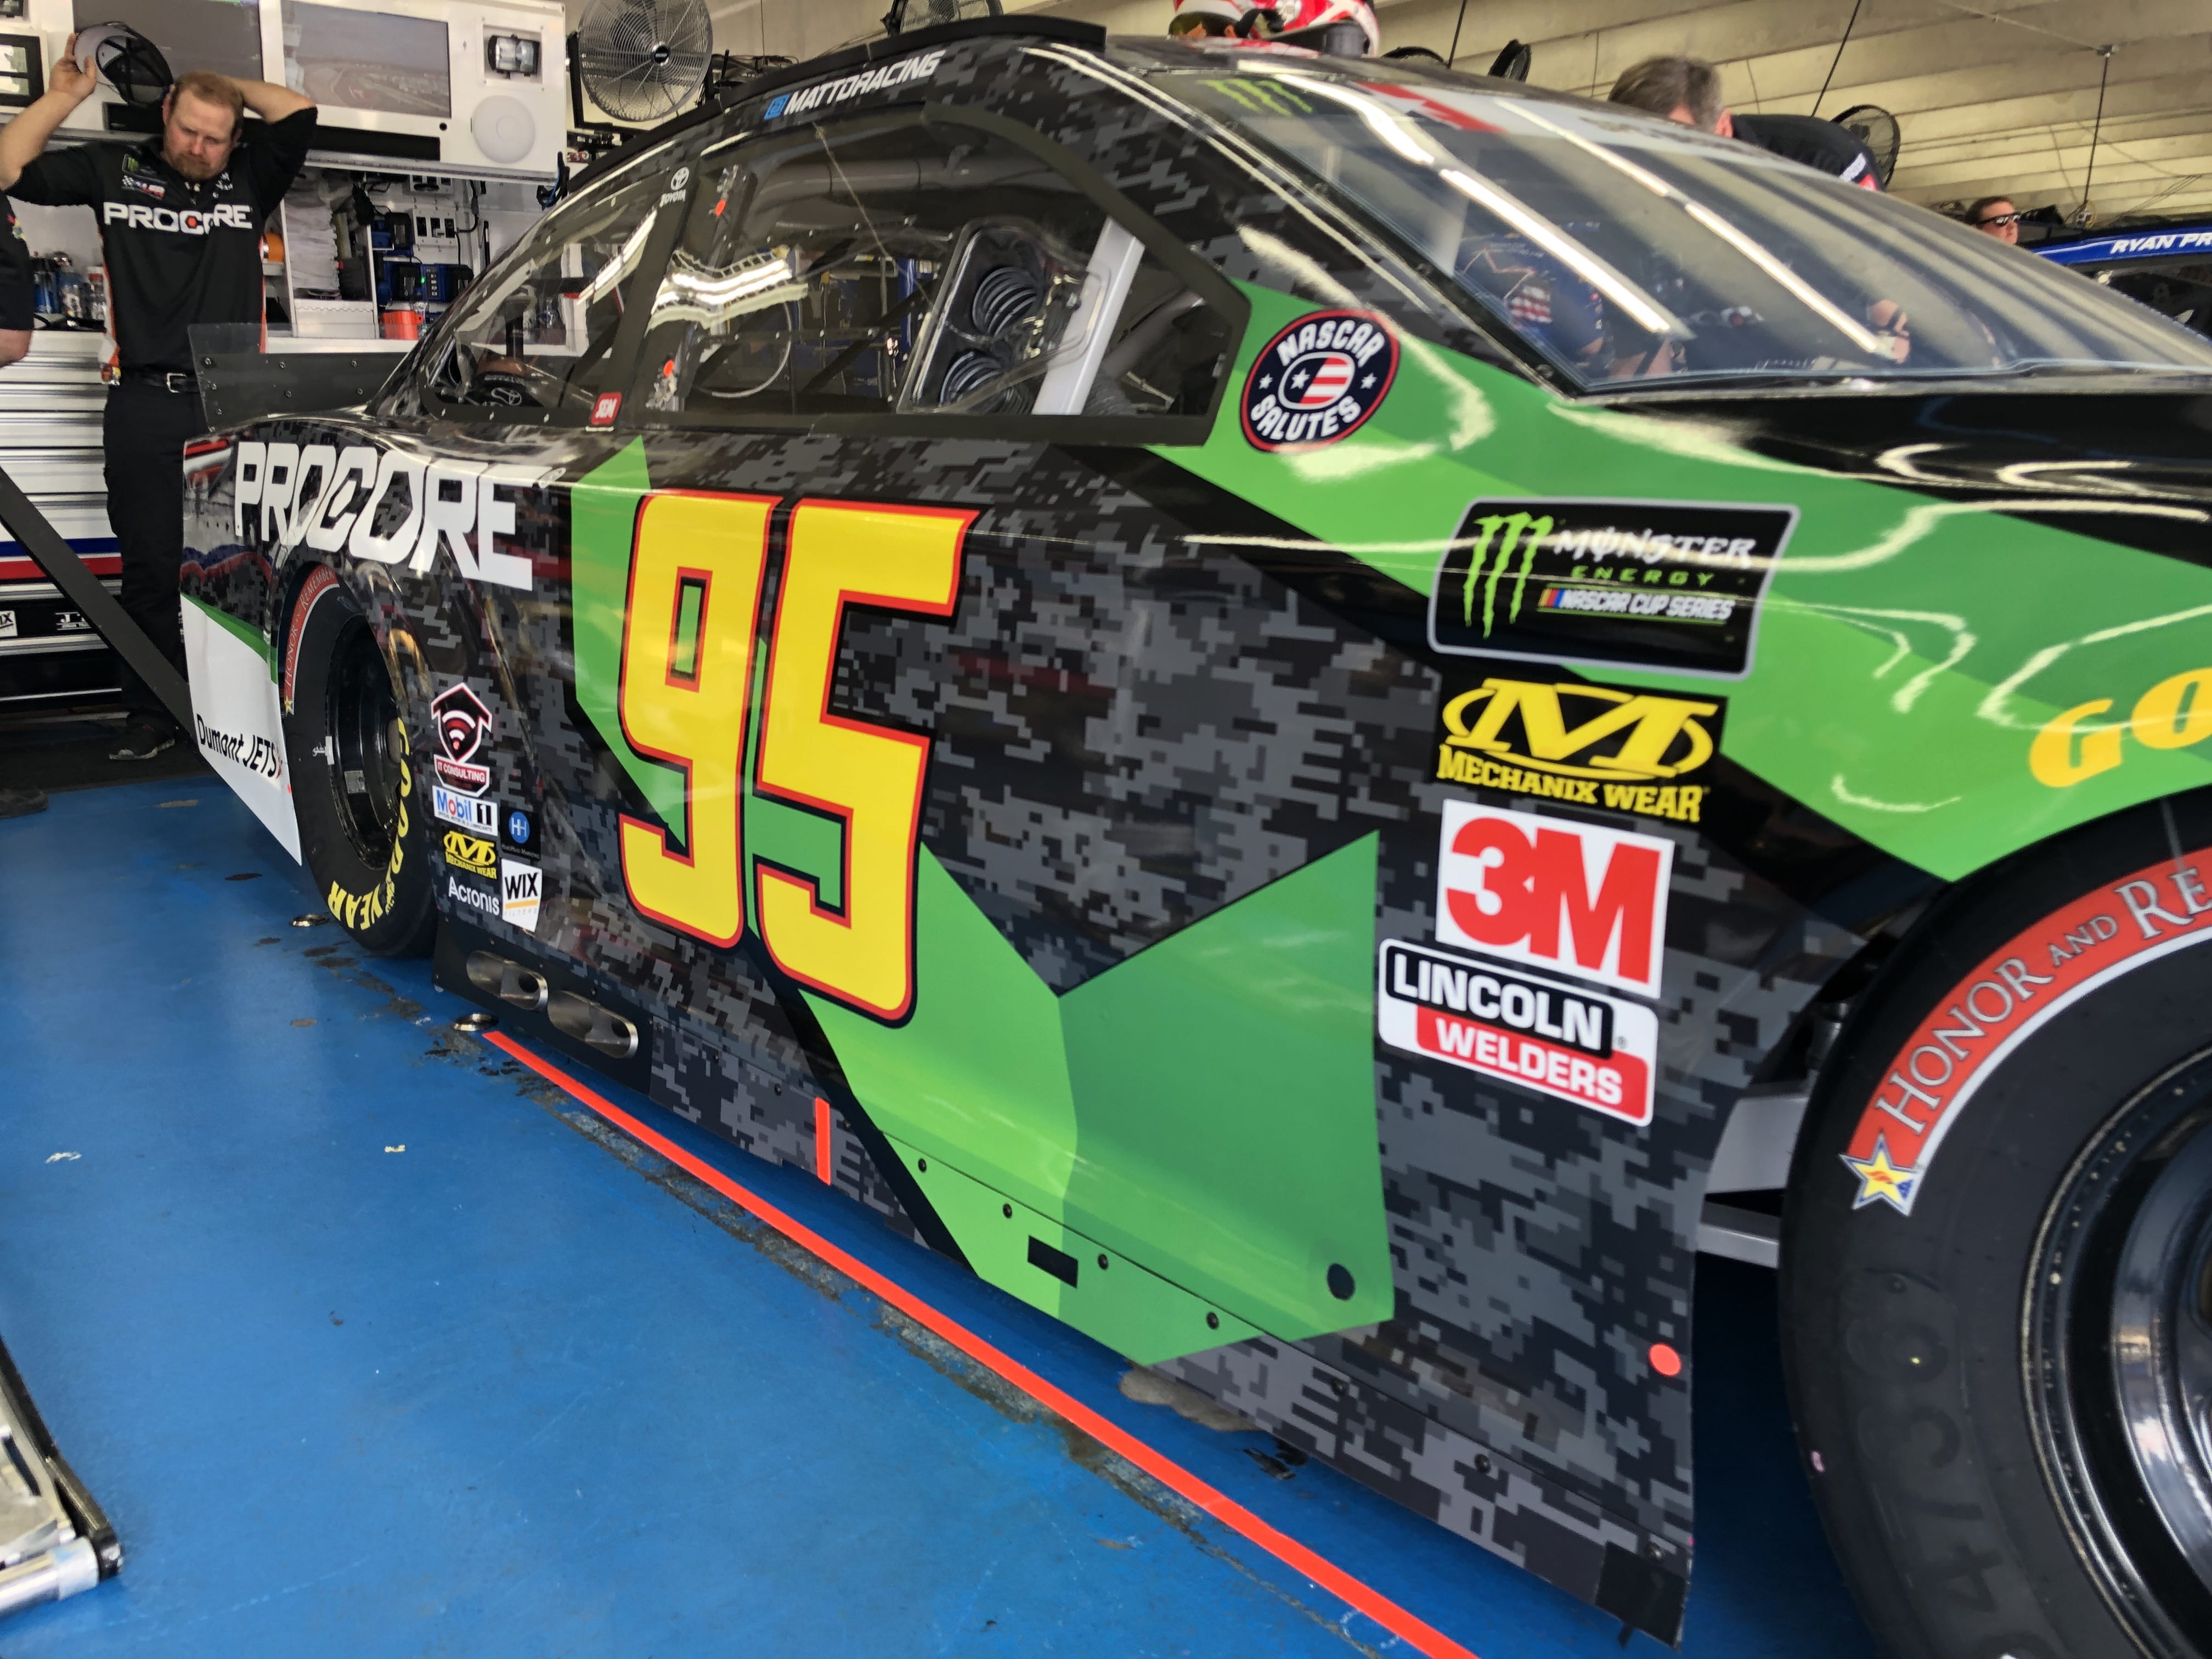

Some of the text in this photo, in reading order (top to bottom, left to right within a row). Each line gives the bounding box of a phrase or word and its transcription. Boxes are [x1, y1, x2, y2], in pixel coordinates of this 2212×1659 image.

[2110, 235, 2177, 254] RYAN
[1277, 320, 1385, 368] NASCAR
[1251, 394, 1362, 441] SALUTES
[235, 442, 555, 591] PROCORE
[1554, 527, 1756, 569] MONSTER
[1571, 566, 1714, 586] ENERGY
[284, 627, 299, 687] HONOR
[300, 566, 335, 611] REMEMBER
[1562, 590, 1736, 620] NASCAR CUP SERIES
[196, 714, 245, 763] Dumont
[242, 735, 276, 777] JETS
[619, 489, 979, 1020] 95
[437, 761, 443, 771] IT
[443, 763, 486, 783] CONSULTING
[1437, 744, 1702, 823] MECHANIX WEAR
[436, 789, 472, 822] Mobil
[478, 804, 489, 826] 1
[445, 851, 497, 880] MECHANIX WEAR
[504, 872, 539, 900] WIX
[448, 876, 500, 916] Acronis
[1446, 817, 1662, 985] 3M
[1393, 953, 1604, 1051] LINCOLN
[1875, 868, 2212, 1136] HONOR AND RE
[1435, 1018, 1623, 1104] WELDERS
